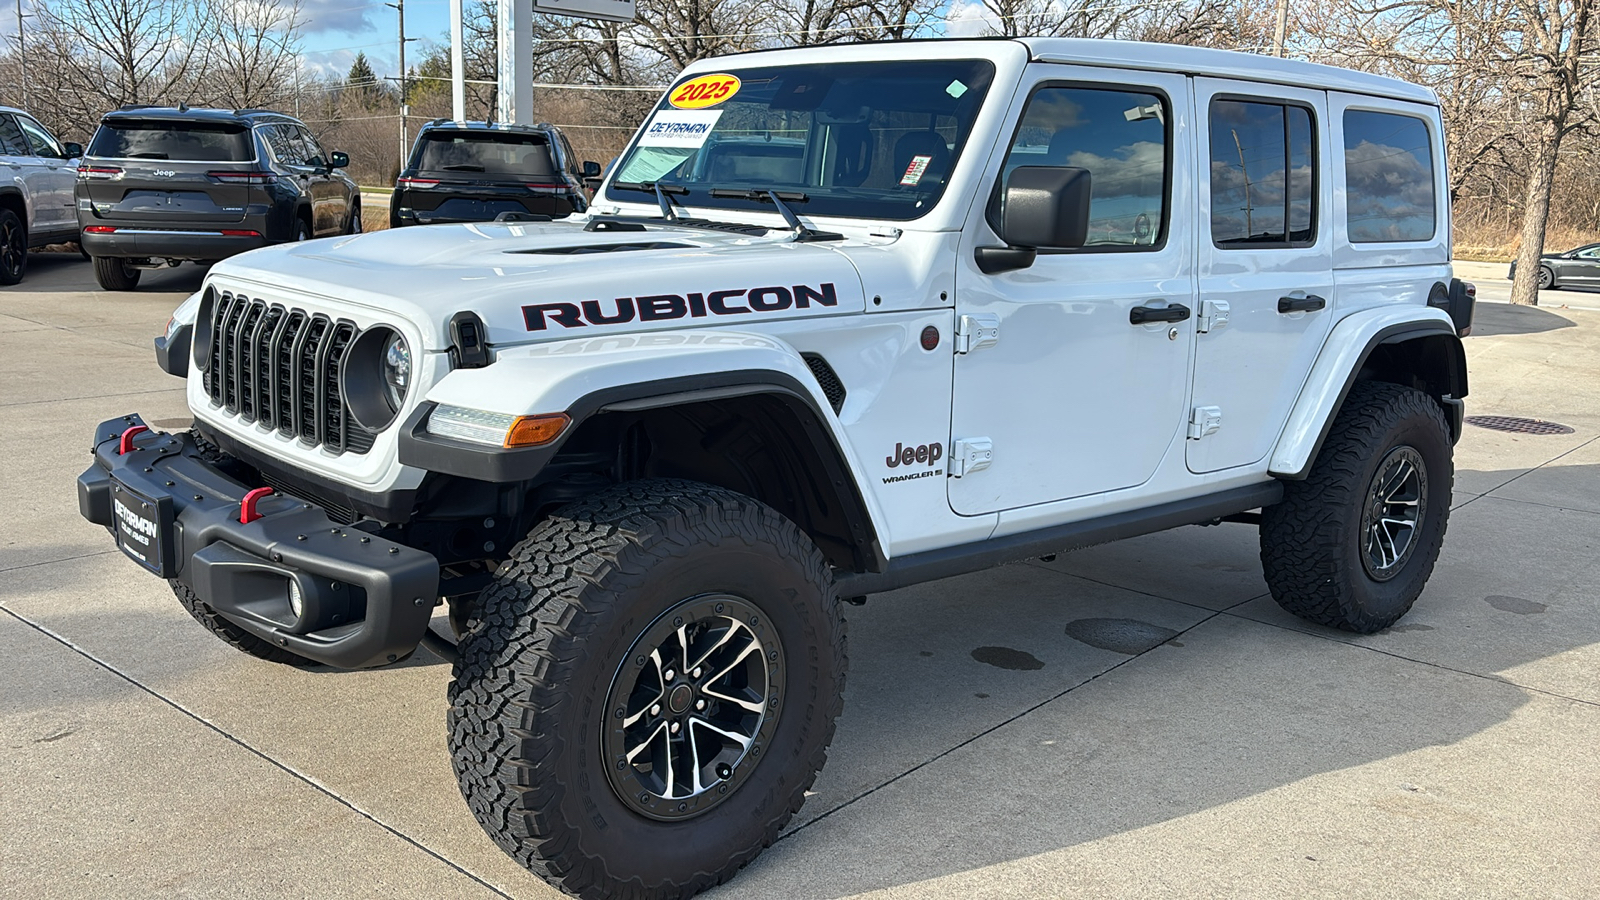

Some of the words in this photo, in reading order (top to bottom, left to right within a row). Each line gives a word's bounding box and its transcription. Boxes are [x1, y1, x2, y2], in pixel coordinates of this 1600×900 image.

[674, 81, 735, 102] 2025
[649, 122, 711, 134] DEYARMAN
[153, 168, 175, 178] Jeep
[521, 283, 838, 331] RUBICON
[886, 442, 943, 468] Jeep
[882, 470, 934, 485] WRANGLER
[114, 498, 157, 538] DEYARMAN
